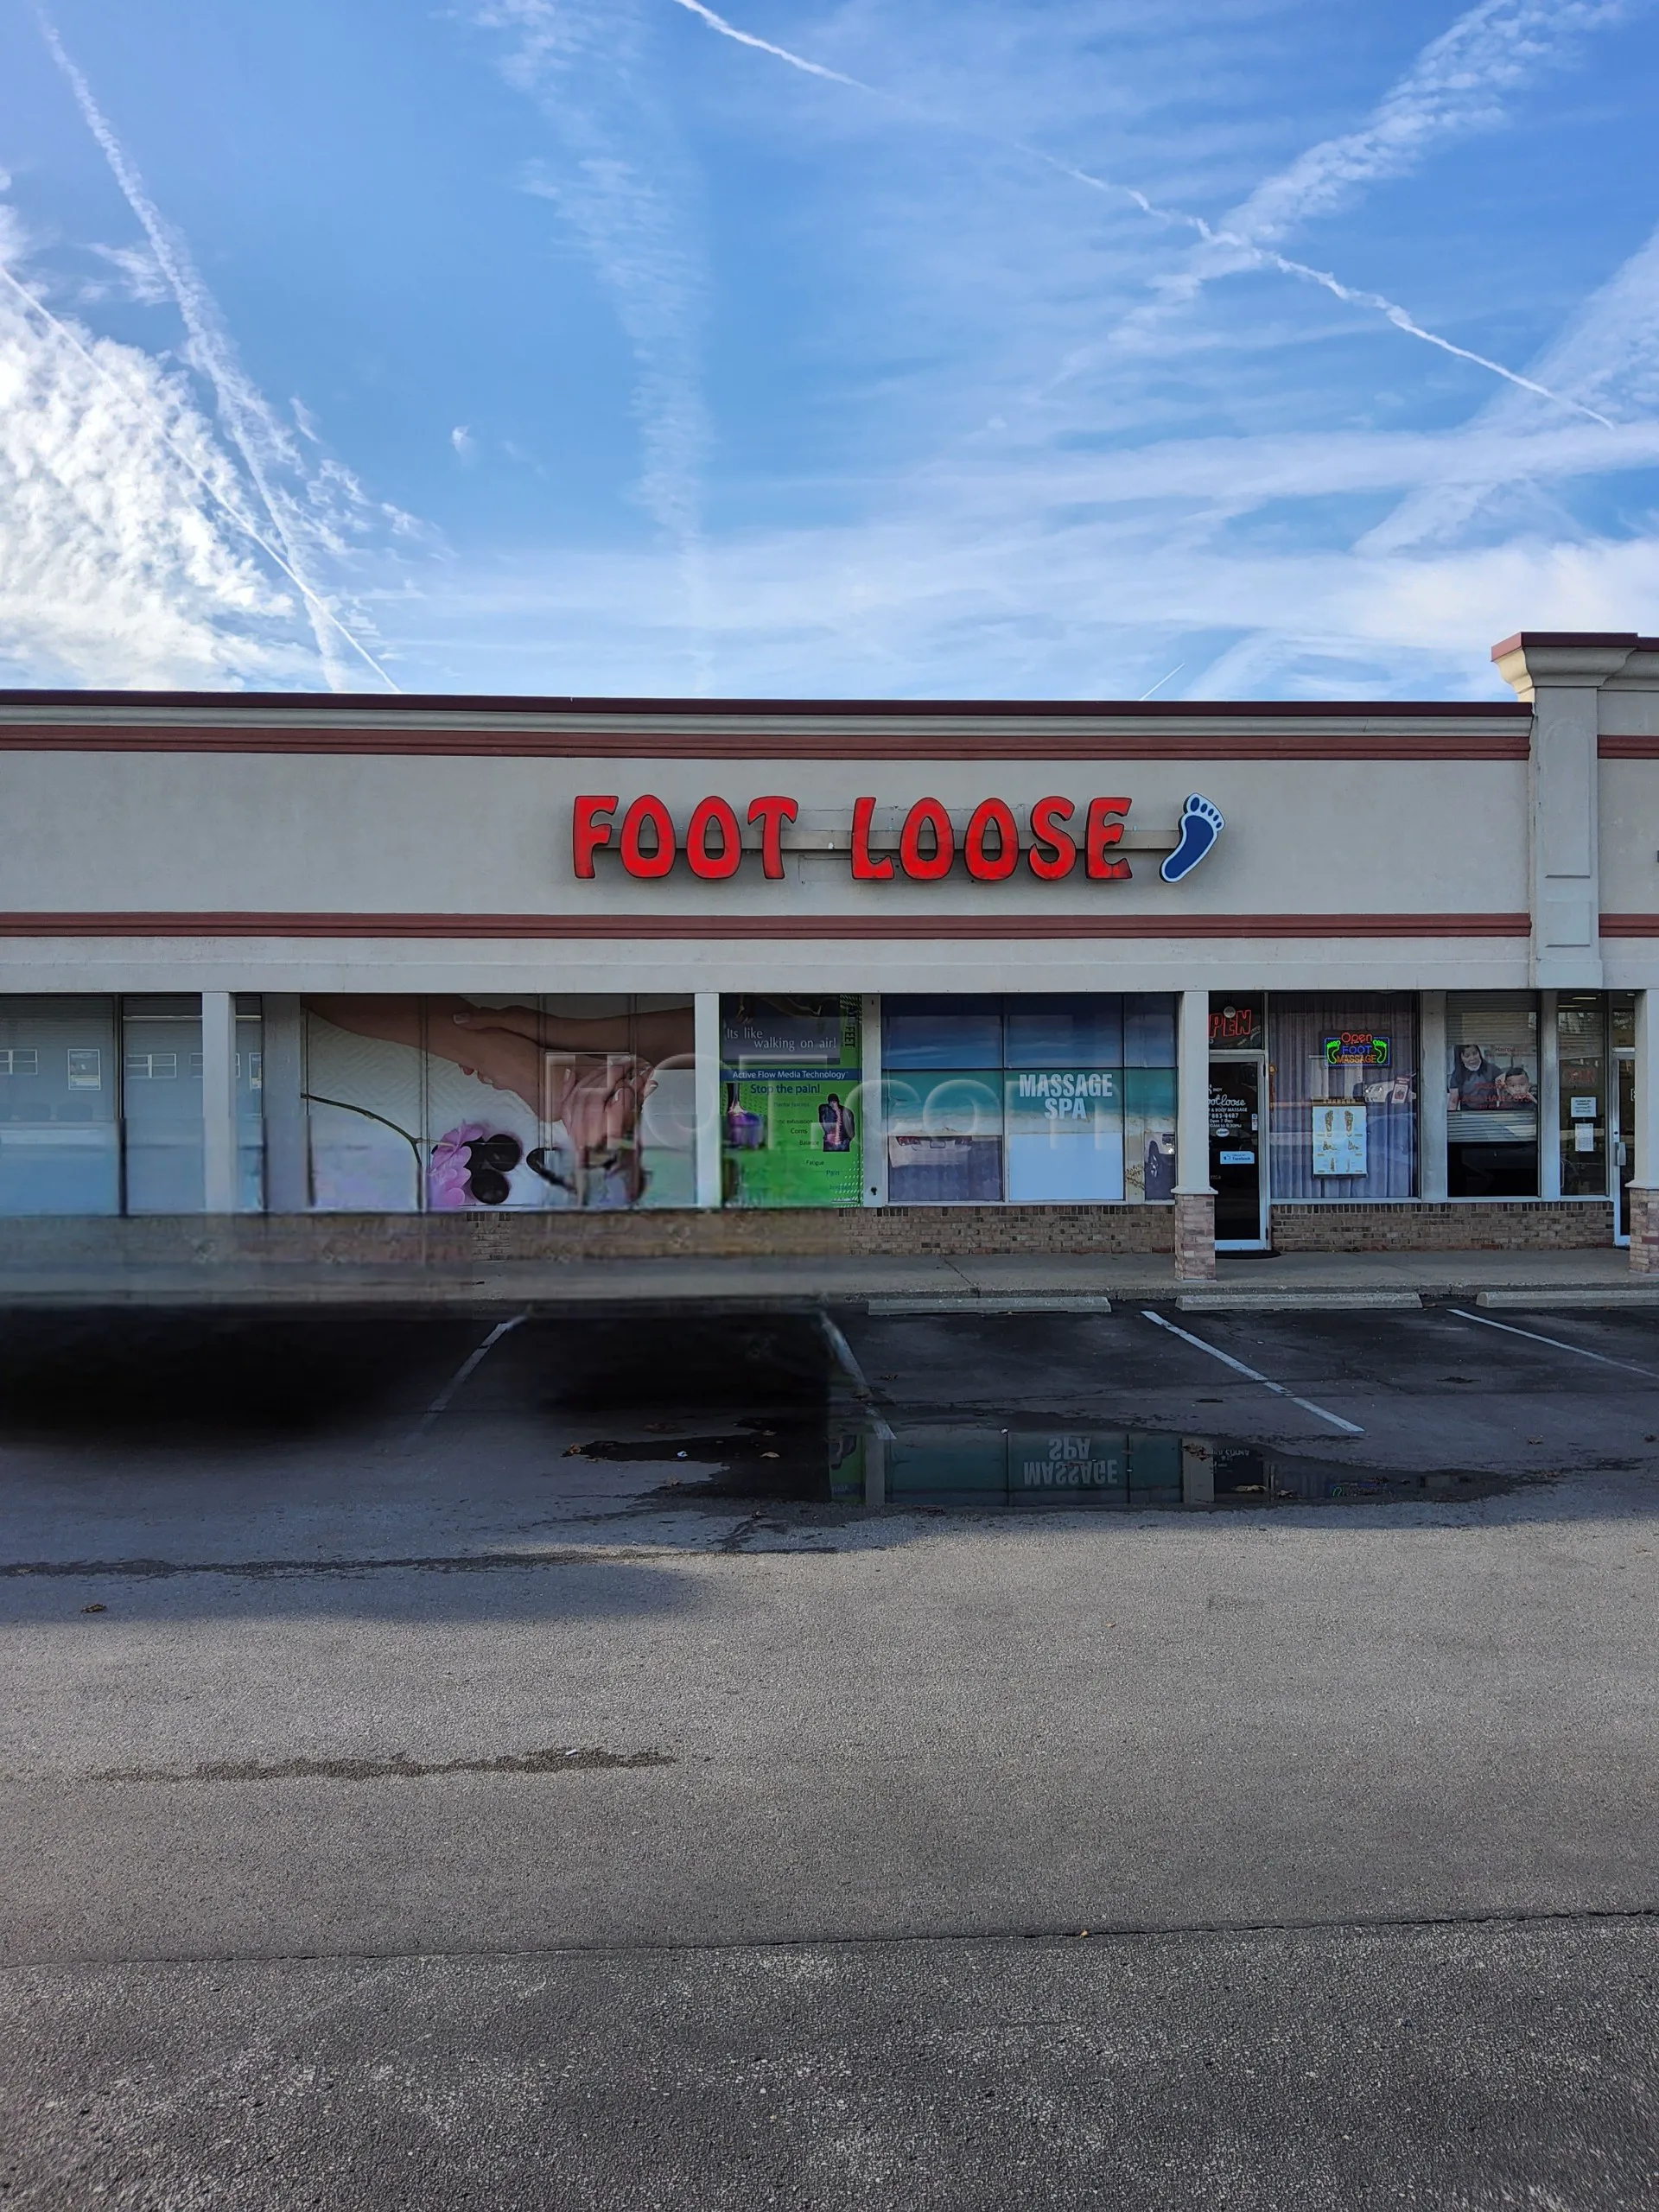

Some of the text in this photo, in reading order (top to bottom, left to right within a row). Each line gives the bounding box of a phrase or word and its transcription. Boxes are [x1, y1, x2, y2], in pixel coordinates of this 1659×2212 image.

[573, 794, 1133, 881] FOOT LOOSE
[1210, 1009, 1252, 1038] PEN
[727, 1027, 763, 1039] Its like
[1341, 1032, 1372, 1044] Open
[753, 1036, 836, 1052] walking on air!
[1342, 1045, 1372, 1055] FOOT
[1337, 1054, 1376, 1064] MASSAGE
[751, 1083, 820, 1095] Stop the pain!
[1019, 1073, 1113, 1097] MASSAGE
[1044, 1097, 1087, 1120] SPA
